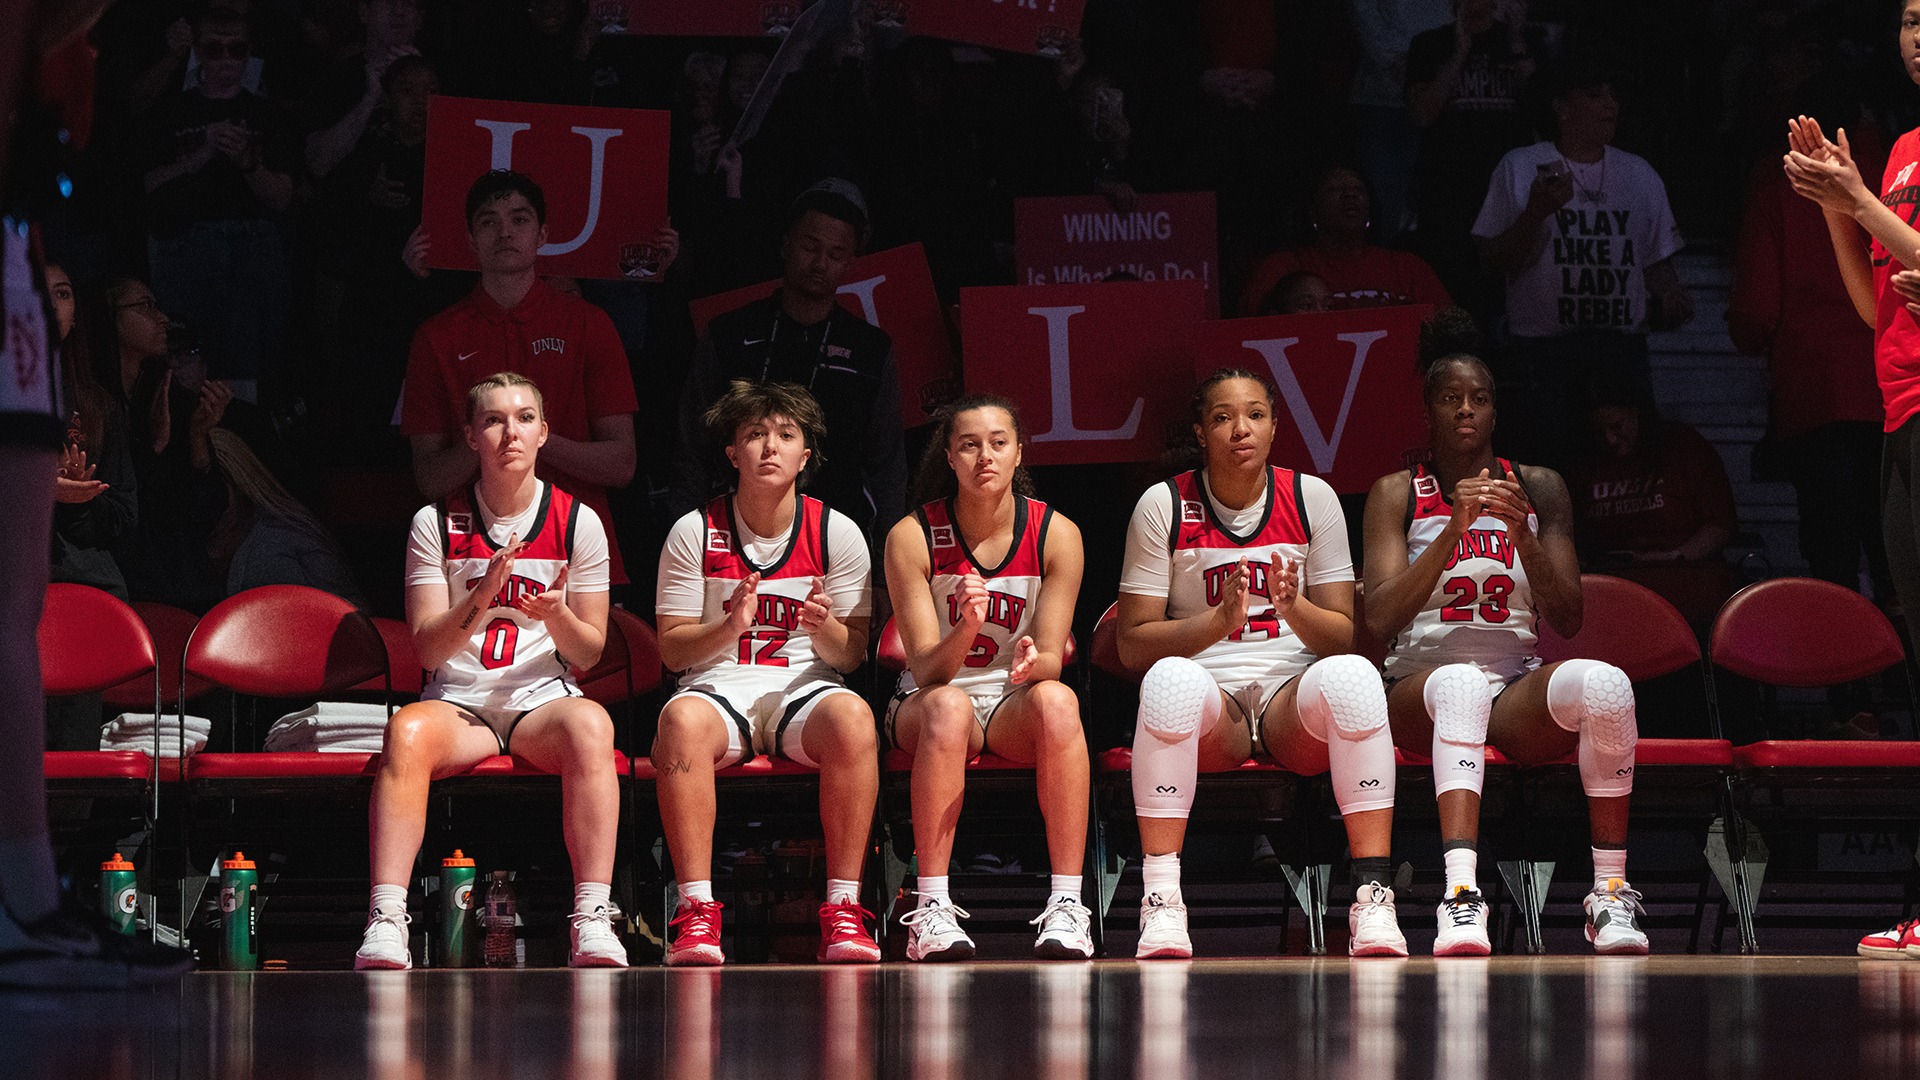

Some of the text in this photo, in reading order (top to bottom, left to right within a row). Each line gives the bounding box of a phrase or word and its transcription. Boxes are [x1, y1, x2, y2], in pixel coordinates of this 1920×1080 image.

[1062, 211, 1172, 243] WINNING
[1559, 209, 1630, 235] PLAY
[1553, 238, 1635, 266] LIKE A
[1561, 268, 1630, 296] LADY
[1557, 298, 1633, 324] REBEL
[531, 337, 566, 355] UNLV
[1027, 305, 1145, 443] L
[1241, 329, 1388, 475] V
[722, 593, 806, 631] NLV
[1440, 574, 1516, 624] 23
[480, 617, 519, 670] 0
[737, 630, 790, 668] 12
